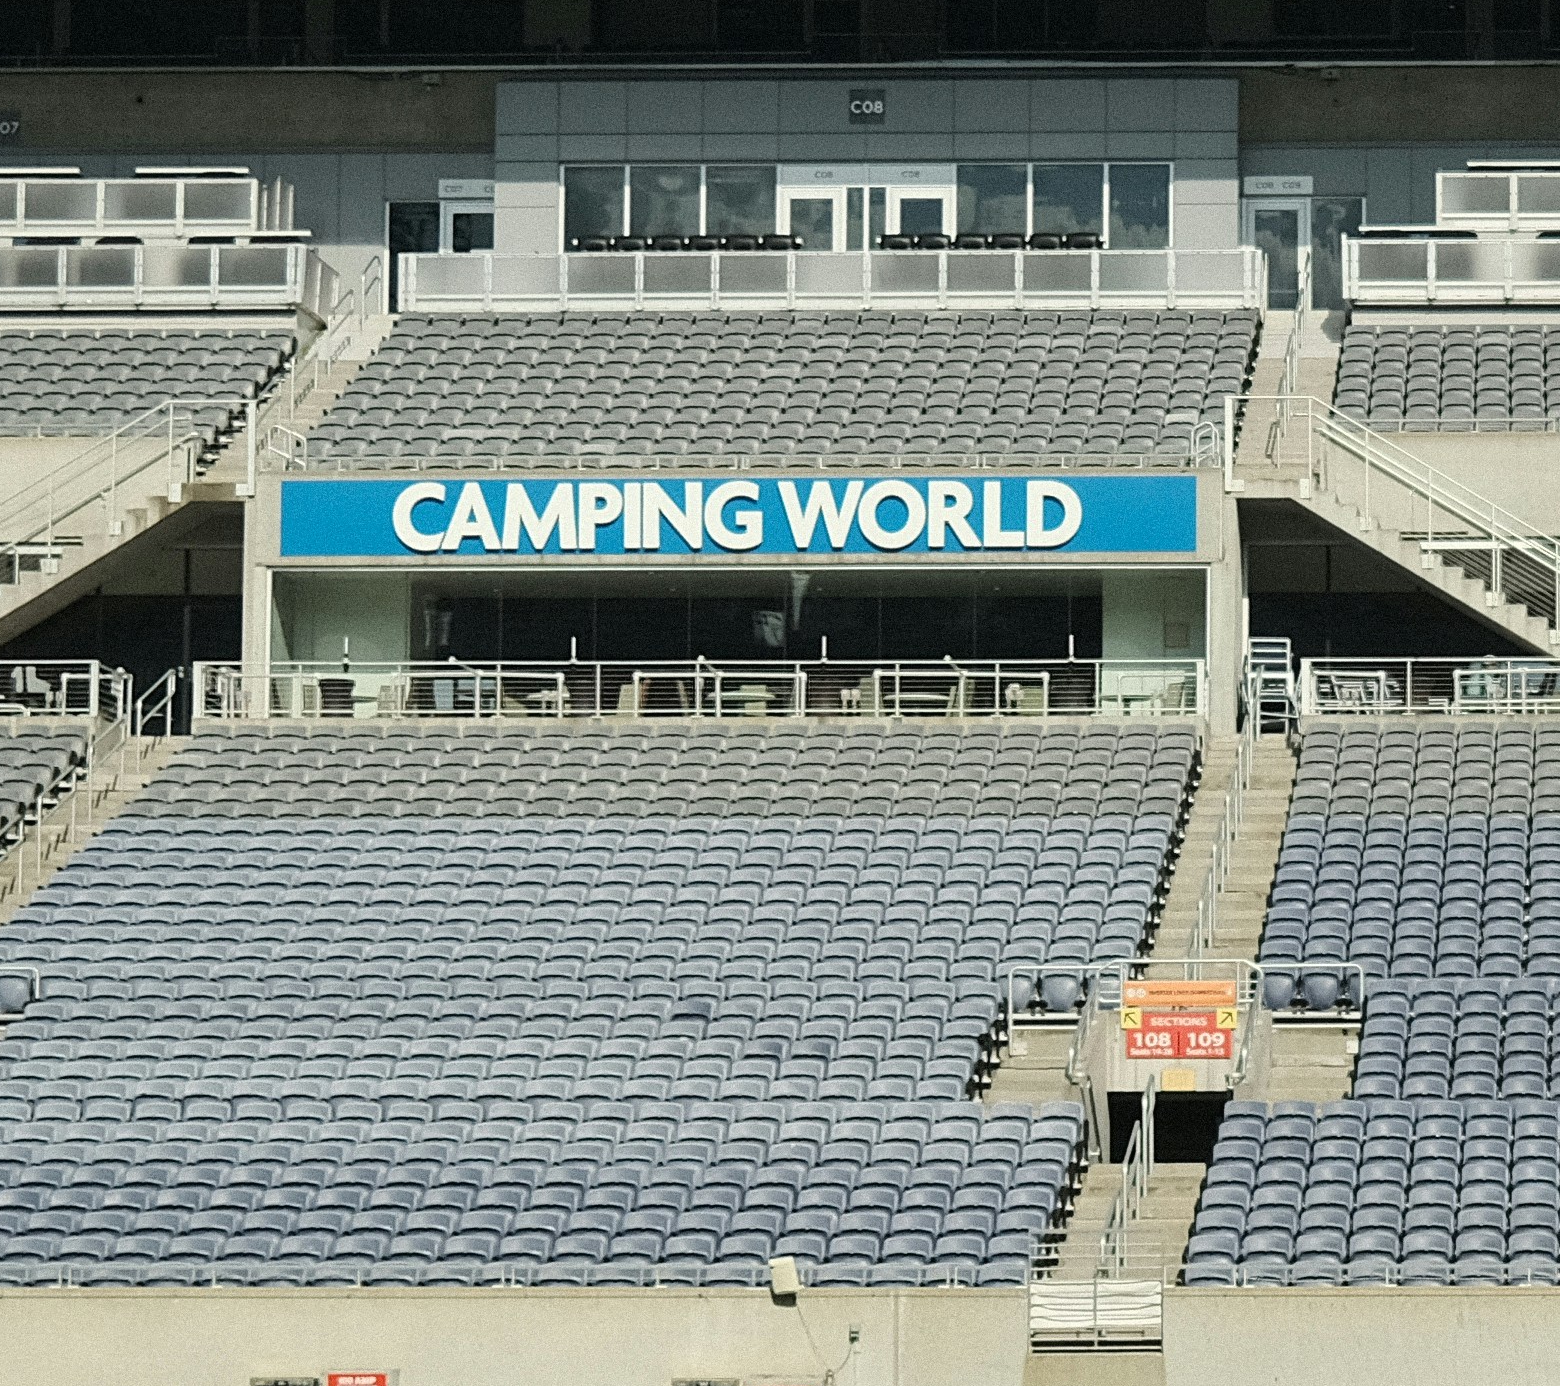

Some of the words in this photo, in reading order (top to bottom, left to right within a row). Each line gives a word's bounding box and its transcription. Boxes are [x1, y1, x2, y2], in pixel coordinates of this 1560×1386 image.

[851, 101, 884, 114] C08
[391, 481, 764, 552] CAMPING
[778, 479, 1083, 550] WORLD
[1151, 1017, 1208, 1026] SECTIONS
[1133, 1033, 1171, 1047] 108
[1187, 1033, 1225, 1047] 109
